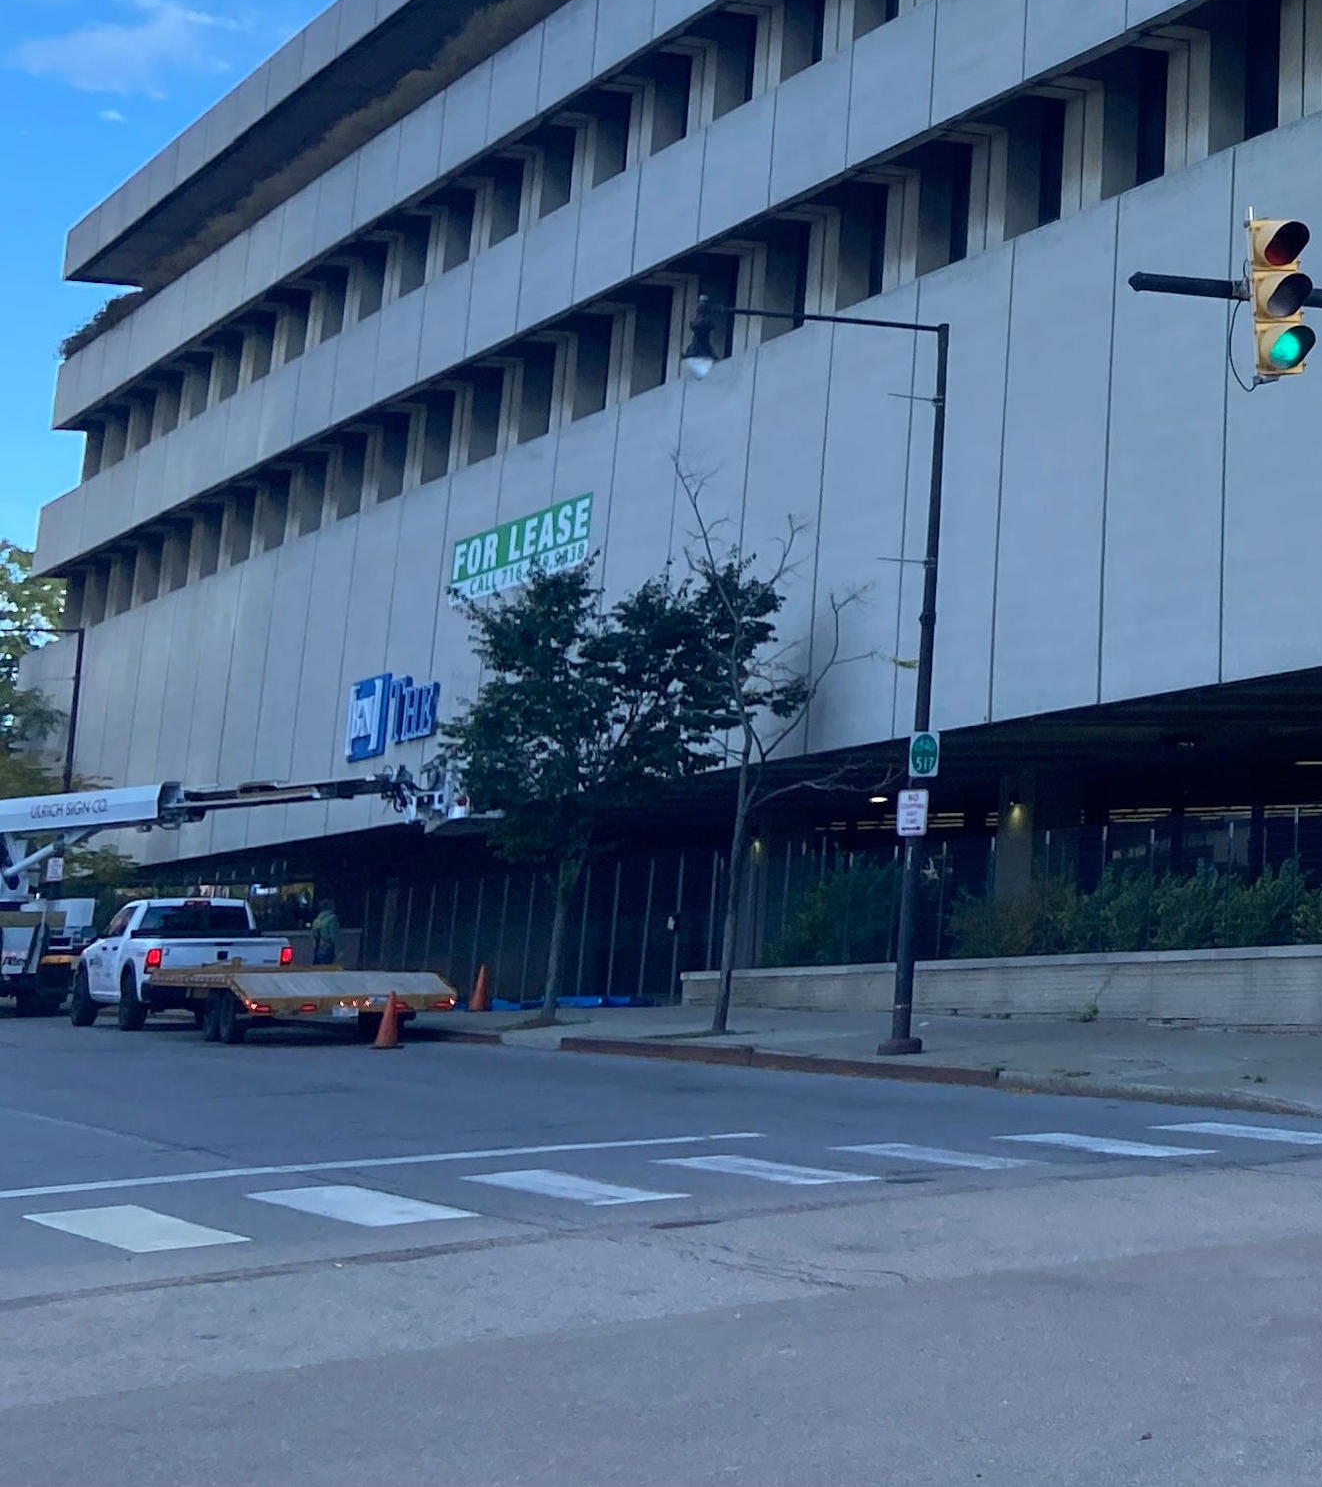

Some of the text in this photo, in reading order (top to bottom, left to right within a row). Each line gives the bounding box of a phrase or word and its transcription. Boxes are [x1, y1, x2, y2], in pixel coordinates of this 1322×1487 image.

[452, 498, 590, 580] FOR LEASE
[470, 572, 496, 595] CALL
[916, 756, 934, 771] 517
[66, 801, 90, 816] SIGN
